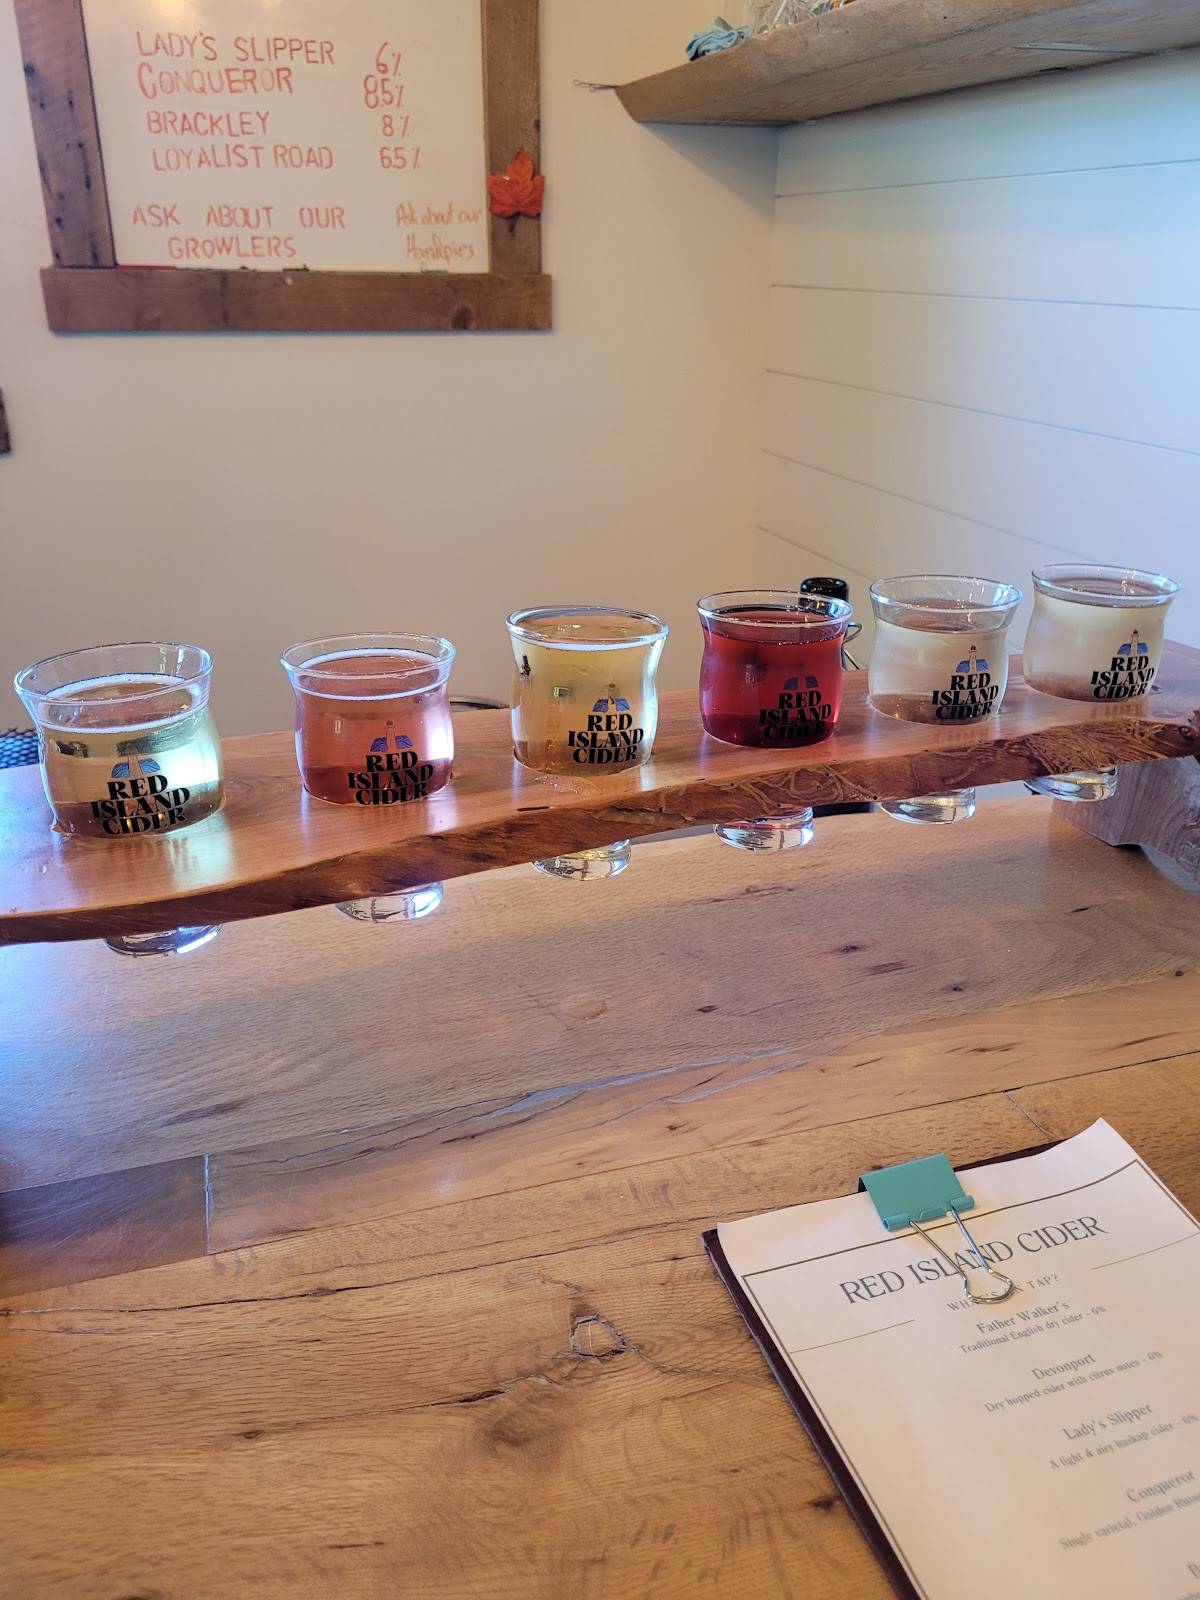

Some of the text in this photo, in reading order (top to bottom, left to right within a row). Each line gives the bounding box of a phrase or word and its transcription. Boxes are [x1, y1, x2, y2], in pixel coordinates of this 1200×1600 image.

[136, 30, 401, 76] LADY'S SLIPPER 6%
[138, 61, 293, 99] CONQUEROR
[146, 110, 270, 137] BRACKLEY
[152, 143, 264, 171] LOYALIST
[273, 144, 334, 169] ROAD
[132, 203, 346, 229] ASK ABOUT OUR
[167, 235, 298, 259] GROWLERS
[1110, 655, 1149, 672] RED
[950, 672, 991, 691] RED
[1091, 667, 1155, 686] ISLAND
[778, 690, 822, 710] RED
[932, 685, 999, 706] ISLAND
[1093, 682, 1148, 699] CIDER
[587, 713, 633, 731] RED
[758, 703, 832, 725] ISLAND
[935, 701, 993, 720] CIDER
[568, 727, 644, 748] ISLAND
[763, 720, 827, 740] CIDER
[365, 750, 418, 772] RED
[572, 745, 638, 764] CIDER
[107, 774, 168, 800] RED
[347, 764, 434, 789] ISLAND
[90, 787, 190, 818] ISLAND
[355, 782, 428, 805] CIDER
[102, 807, 186, 834] CIDER
[838, 1215, 1108, 1305] RED ISLAND CIDER
[1027, 1273, 1059, 1290] TAP?
[958, 1334, 1010, 1355] Traditional
[1009, 1324, 1045, 1341] English
[1045, 1319, 1060, 1331] dry
[1061, 1311, 1084, 1326] cider
[1091, 1304, 1107, 1316] 6%
[976, 1300, 1071, 1334] Father Walker's
[1031, 1353, 1097, 1380] Devonport
[984, 1400, 1005, 1414] Dry
[1005, 1387, 1042, 1408] hopped
[1042, 1380, 1066, 1396] cider
[1067, 1374, 1089, 1389] with
[1089, 1366, 1116, 1381] citrus
[1116, 1358, 1142, 1373] notes
[1062, 1403, 1153, 1441] Lady's Slipper
[1049, 1459, 1060, 1470] A
[1060, 1452, 1084, 1467] light
[1150, 1421, 1175, 1437] cider
[1126, 1470, 1196, 1503] Conqueror
